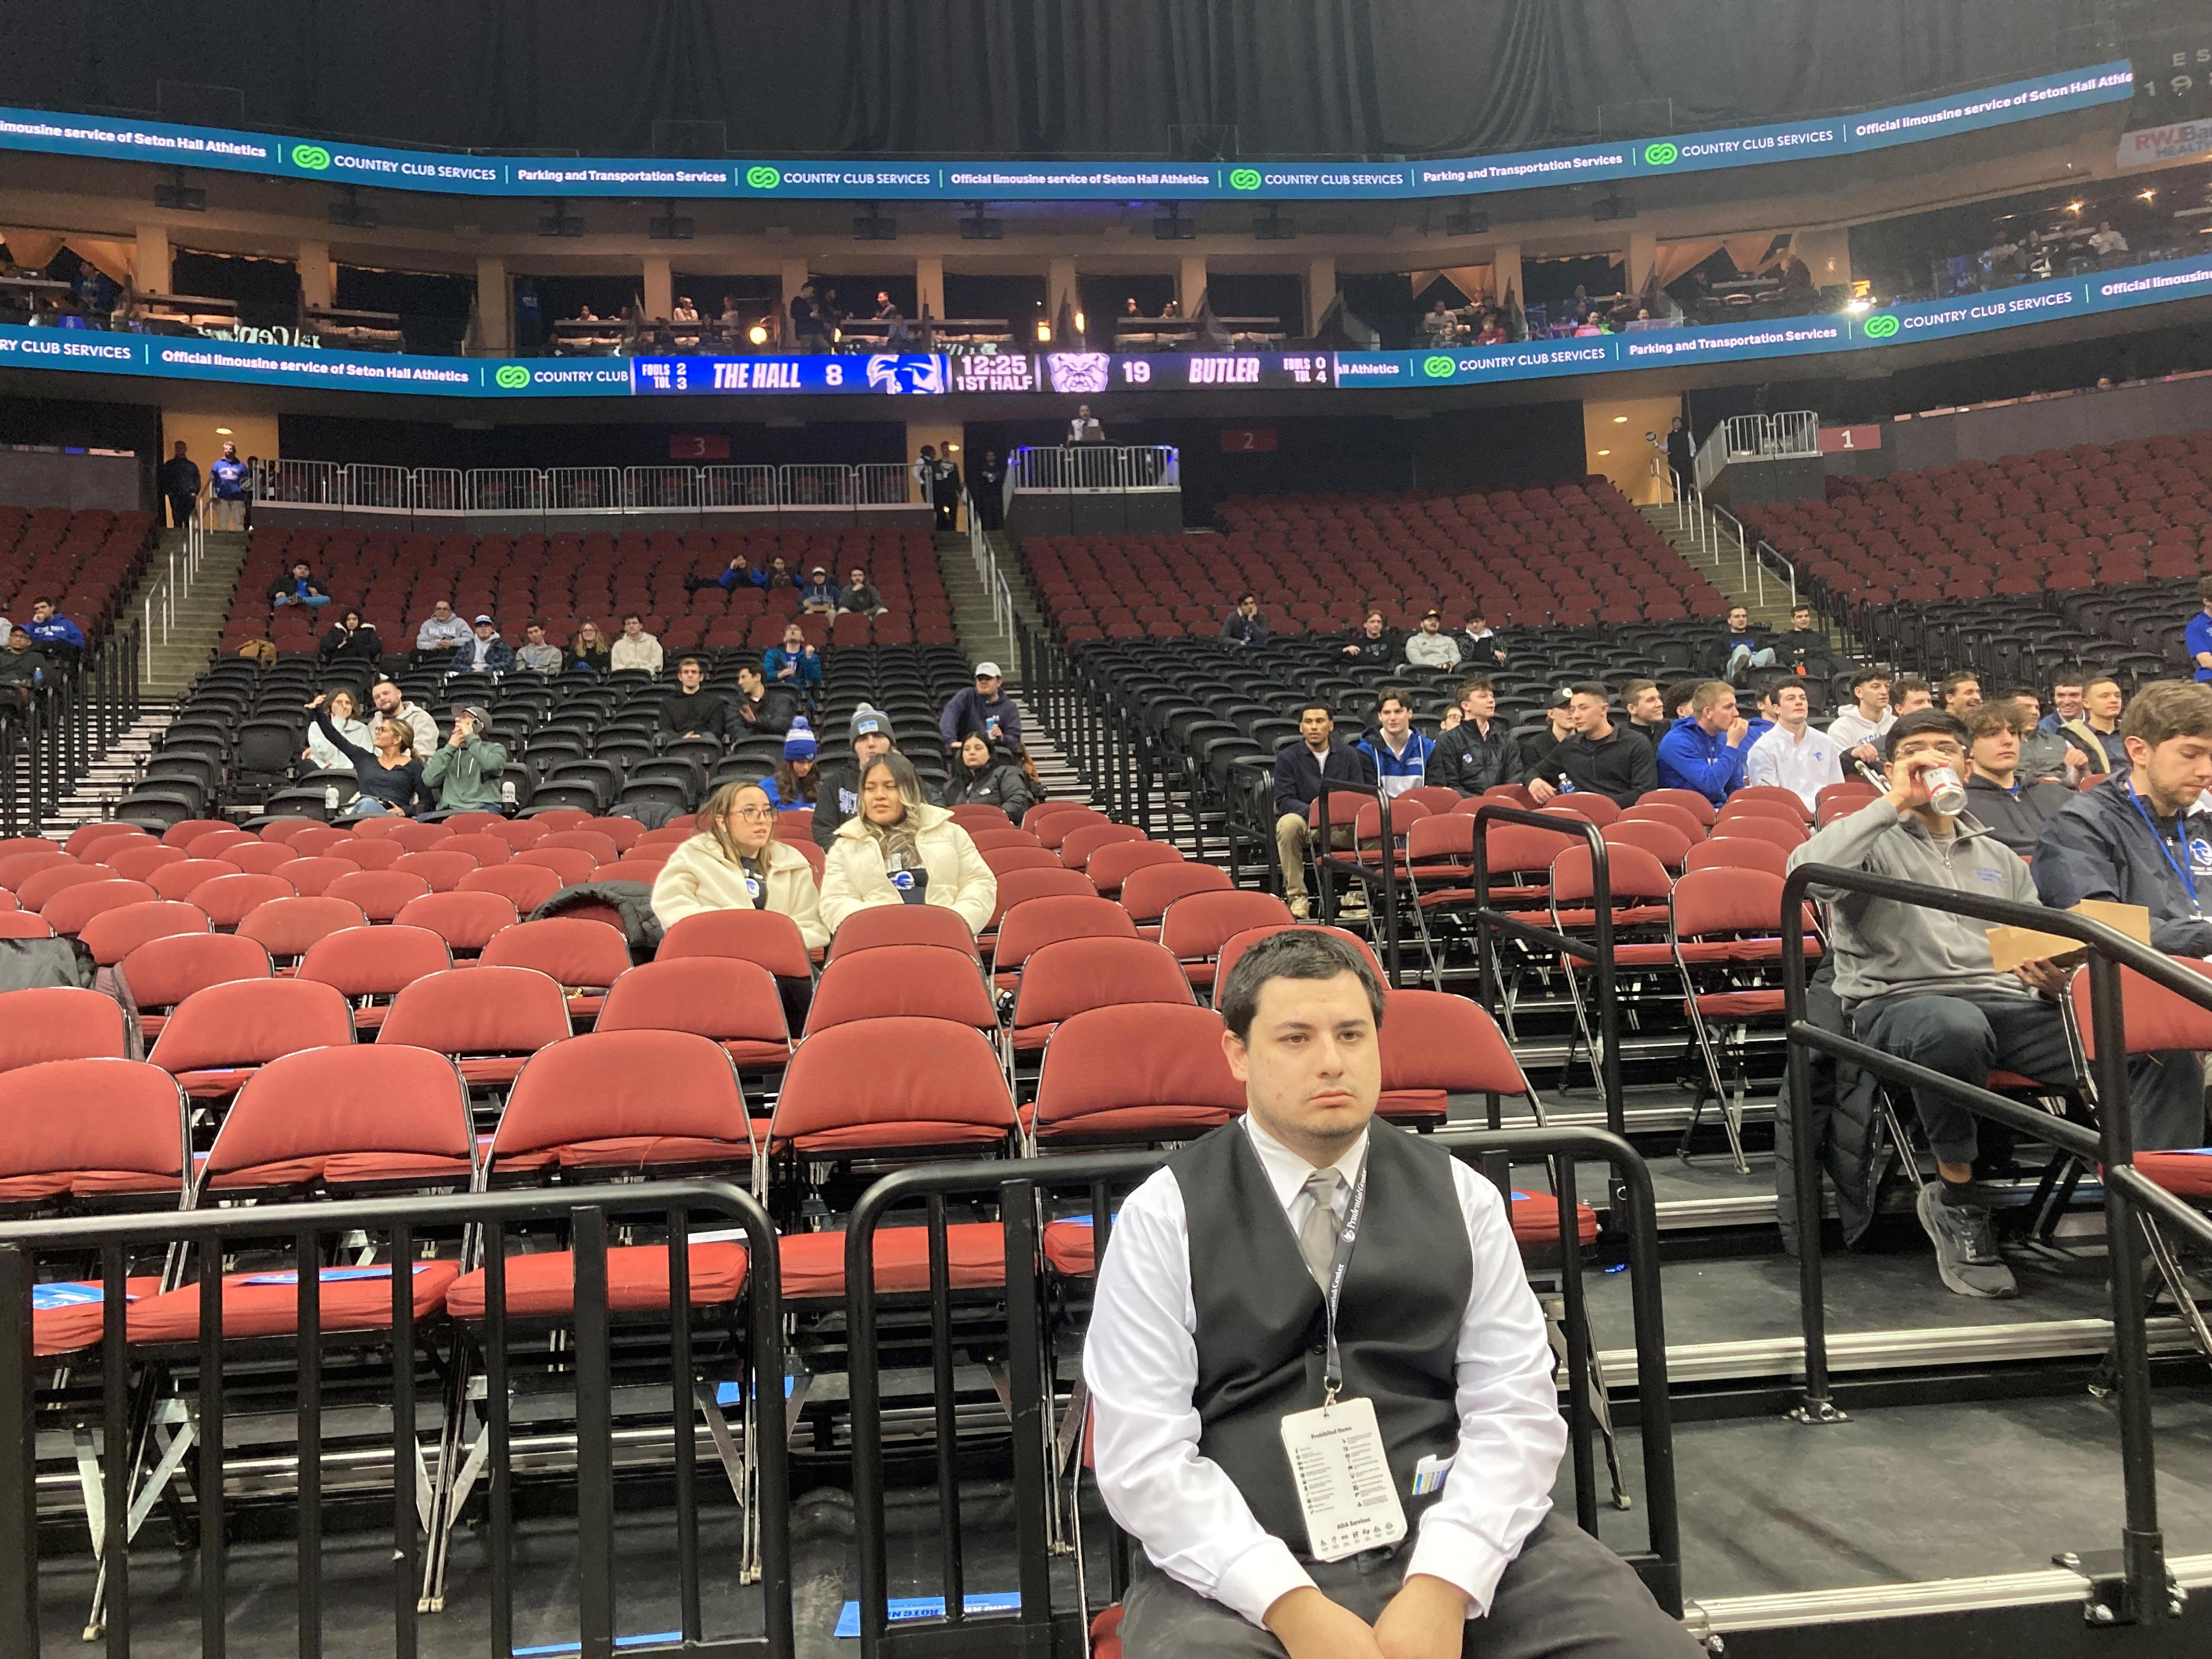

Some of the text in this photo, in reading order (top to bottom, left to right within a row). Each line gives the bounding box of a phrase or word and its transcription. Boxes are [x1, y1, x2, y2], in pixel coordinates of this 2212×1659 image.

[1856, 119, 1900, 136] Official
[1902, 109, 1962, 128] limousine
[1964, 98, 2011, 115] service
[2013, 93, 2027, 105] of
[2029, 86, 2069, 102] Seton
[2070, 79, 2097, 93] Hall
[64, 128, 115, 141] service
[117, 132, 133, 143] of
[134, 133, 175, 147] Seton
[177, 137, 204, 150] Hall
[205, 141, 267, 157] Athletics
[1681, 130, 1833, 157] COUNTRY CLUB SERVICES
[334, 156, 496, 180] COUNTRY CLUB SERVICES
[518, 170, 726, 182] Parking and Transportation Services
[1423, 155, 1623, 182] Parking and Transportation Services
[784, 173, 930, 184] COUNTRY CLUB SERVICES
[951, 173, 1209, 184] Official limousine service of Seton Hall Athletics
[1265, 174, 1403, 185] COUNTRY CLUB SERVICES
[2102, 278, 2151, 296] Official
[1904, 292, 2072, 329] COUNTRY CLUB SERVICES
[21, 340, 60, 354] CLUB
[64, 343, 131, 359] SERVICES
[1630, 329, 1838, 355] Parking and Transportation Services
[162, 350, 469, 382] Official limousine service of Seton Hall Athletics
[961, 355, 1028, 375] 12:25
[1459, 348, 1605, 371] COUNTRY CLUB SERVICES
[534, 371, 628, 382] COUNTRY CLUB
[642, 363, 687, 376] FOULS 2
[714, 363, 843, 388] THE HALL 8
[1122, 358, 1260, 383] 19 BUTLER
[1315, 370, 1327, 383] 4
[1350, 364, 1399, 374] Athletics
[653, 376, 687, 390] TOL 3
[956, 375, 1033, 390] 1ST HALF
[693, 437, 706, 455] 3
[1243, 432, 1254, 449] 2
[1842, 430, 1854, 448] 1
[1347, 1168, 1367, 1229] Prudential Center
[1332, 1263, 1344, 1289] Center
[1311, 1429, 1337, 1439] Prohibited
[1350, 1517, 1371, 1526] Services
